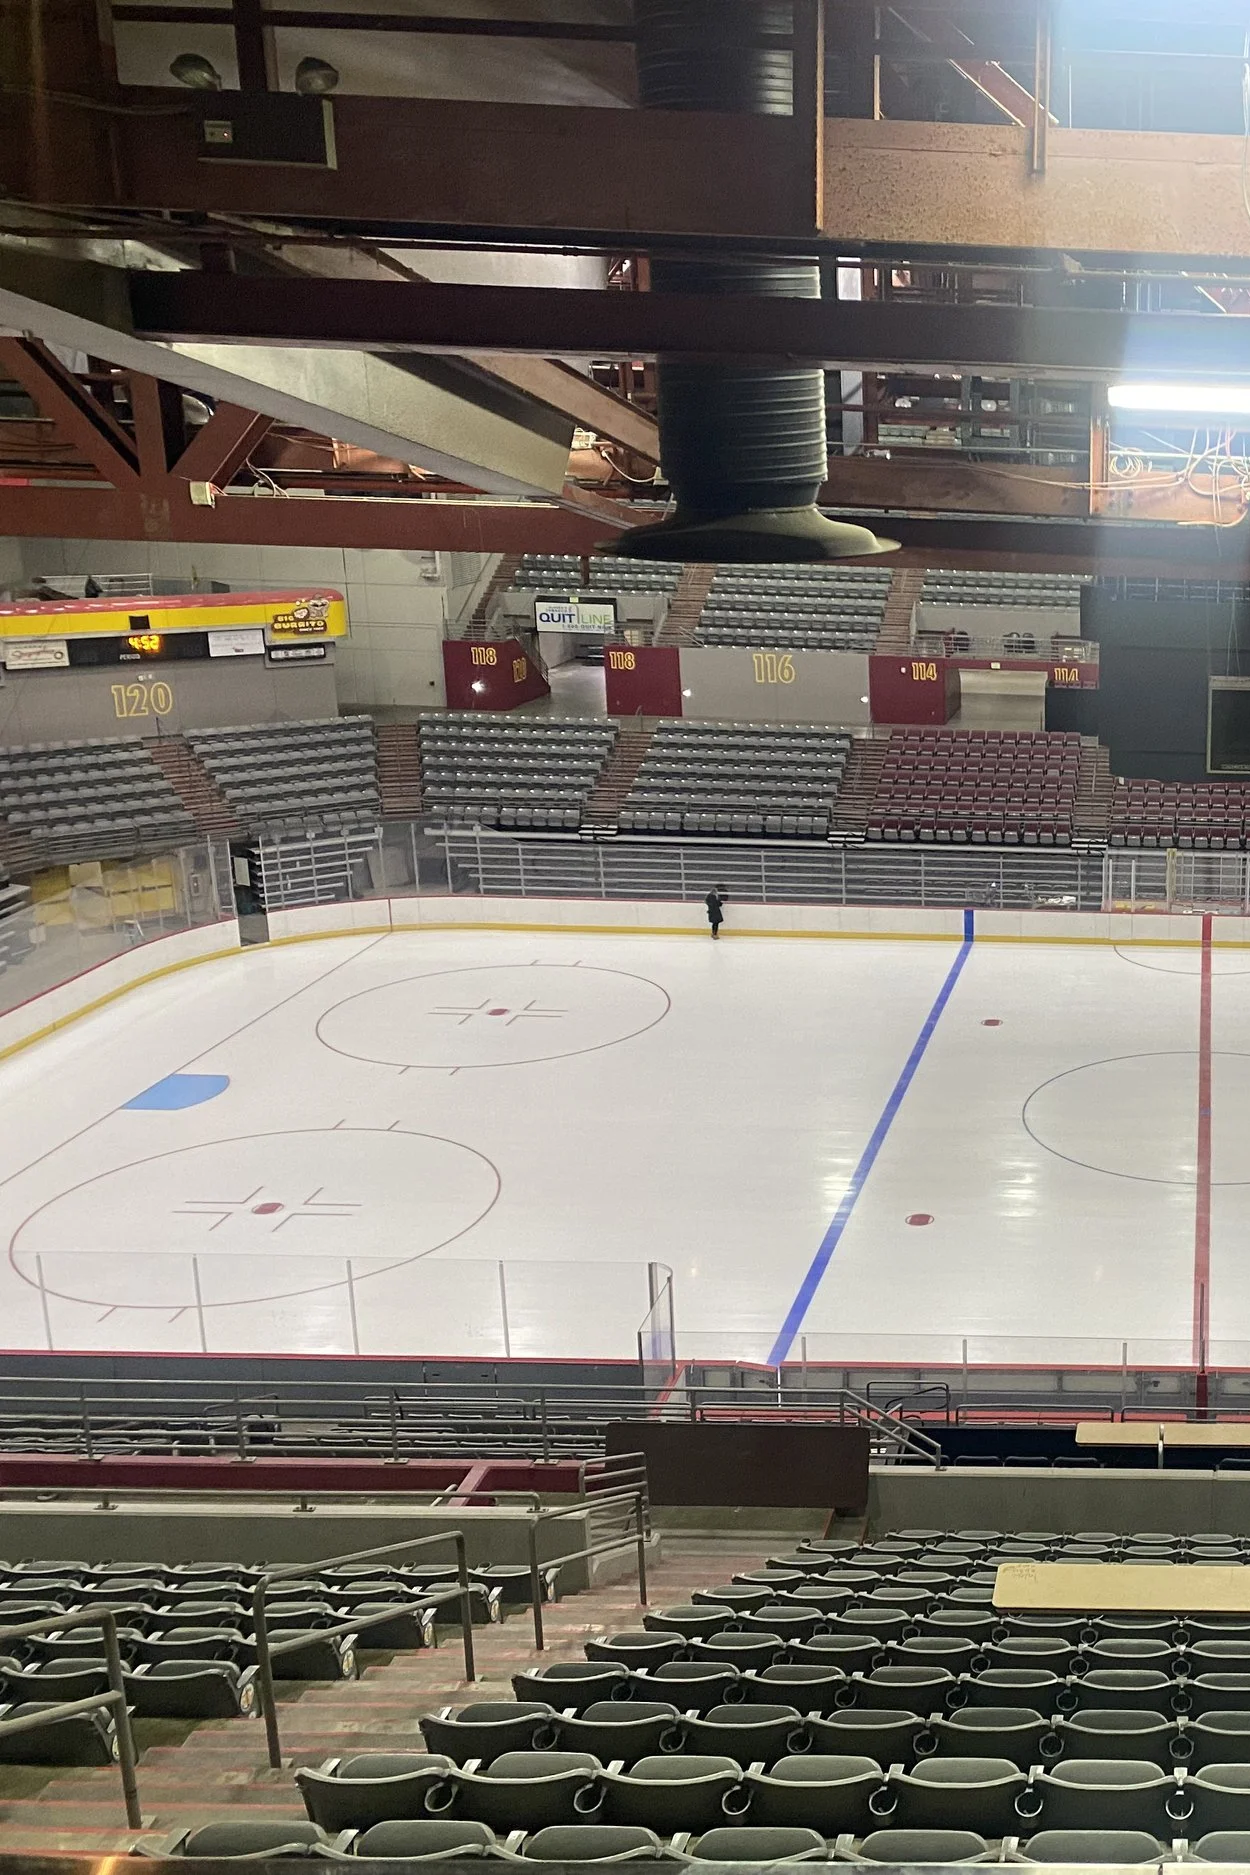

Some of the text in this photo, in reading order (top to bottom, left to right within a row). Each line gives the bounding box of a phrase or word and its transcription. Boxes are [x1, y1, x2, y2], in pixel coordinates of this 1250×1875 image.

[273, 620, 325, 630] BURRITO
[539, 612, 612, 625] QUIT LINE
[128, 634, 160, 651] 4:52
[471, 647, 497, 665] 118
[609, 651, 636, 670] 118
[753, 653, 796, 684] 116
[911, 662, 937, 681] 114
[111, 682, 173, 718] 120
